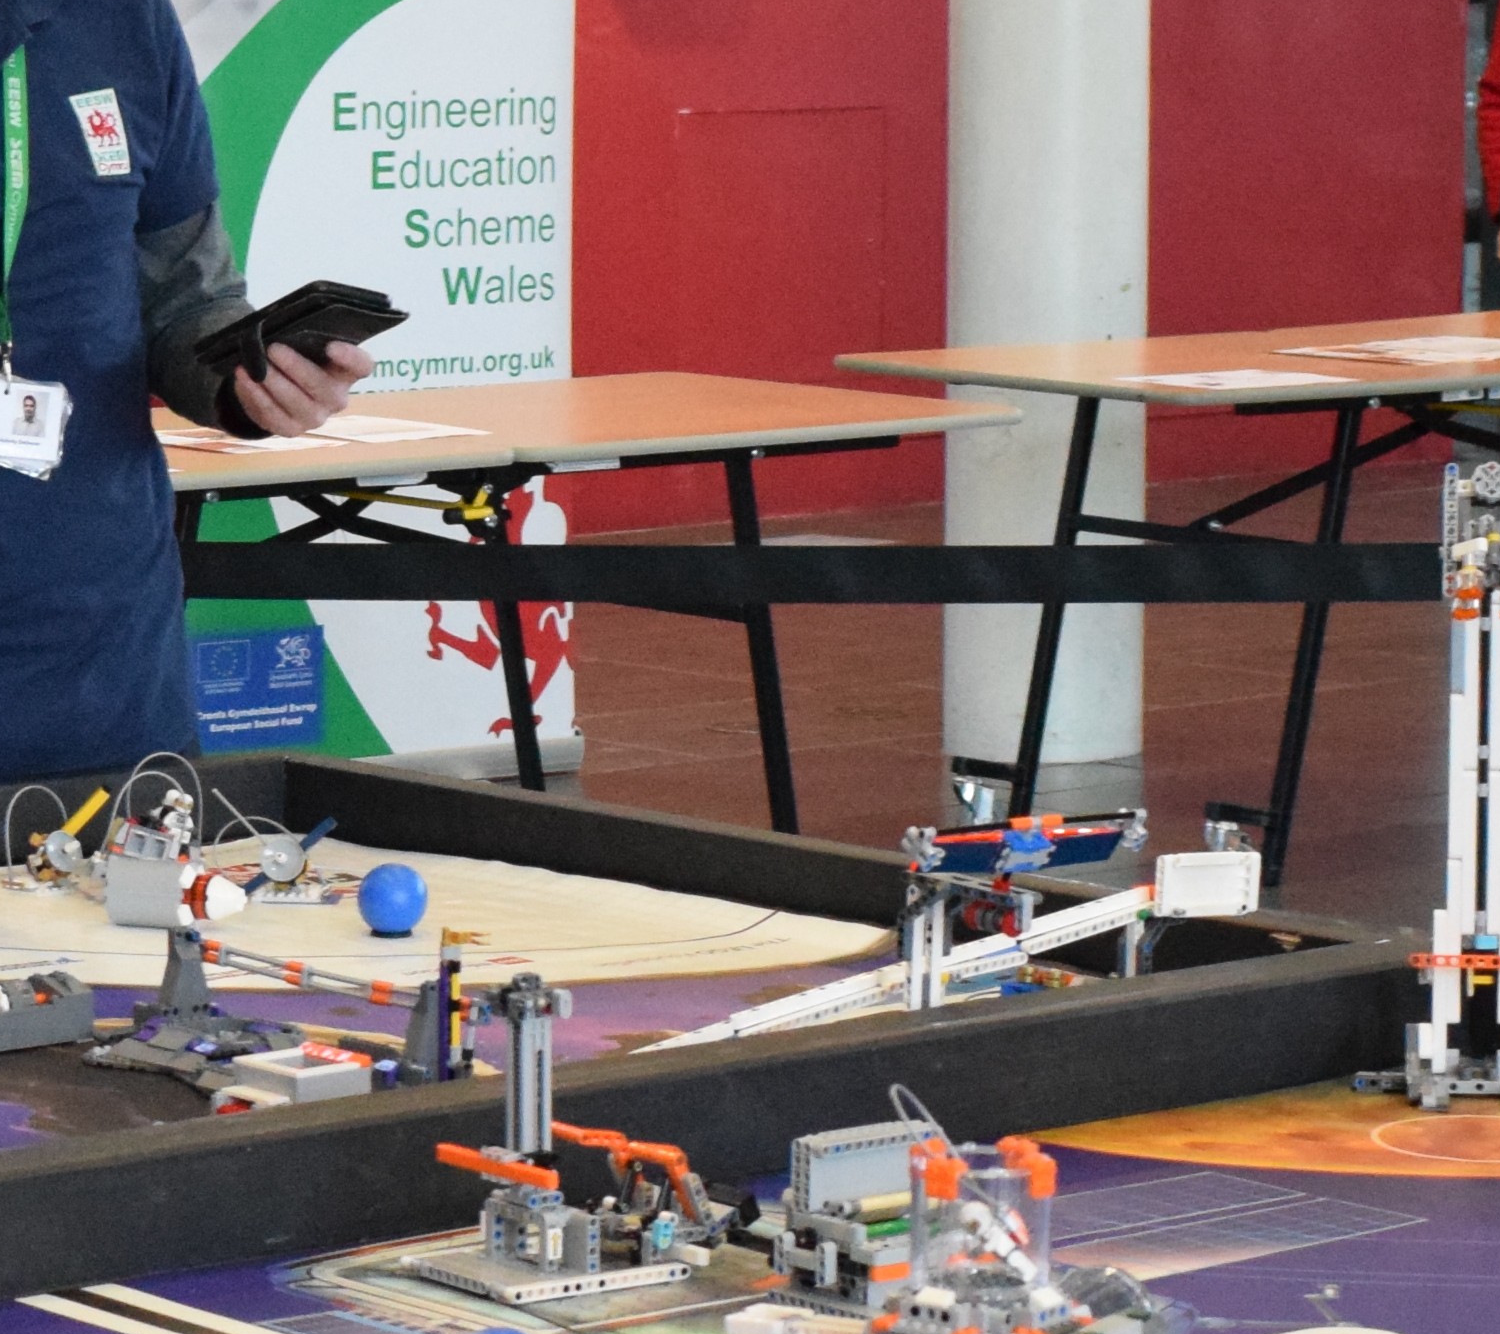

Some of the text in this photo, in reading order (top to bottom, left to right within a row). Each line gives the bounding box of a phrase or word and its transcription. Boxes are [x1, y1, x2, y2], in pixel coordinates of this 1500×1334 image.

[7, 77, 22, 127] EESW
[76, 93, 113, 108] EESW
[333, 87, 556, 140] Engineering
[371, 147, 556, 189] Education
[404, 208, 555, 248] Scheme
[442, 265, 555, 305] Wales
[373, 345, 555, 382] mcymru.org.uk
